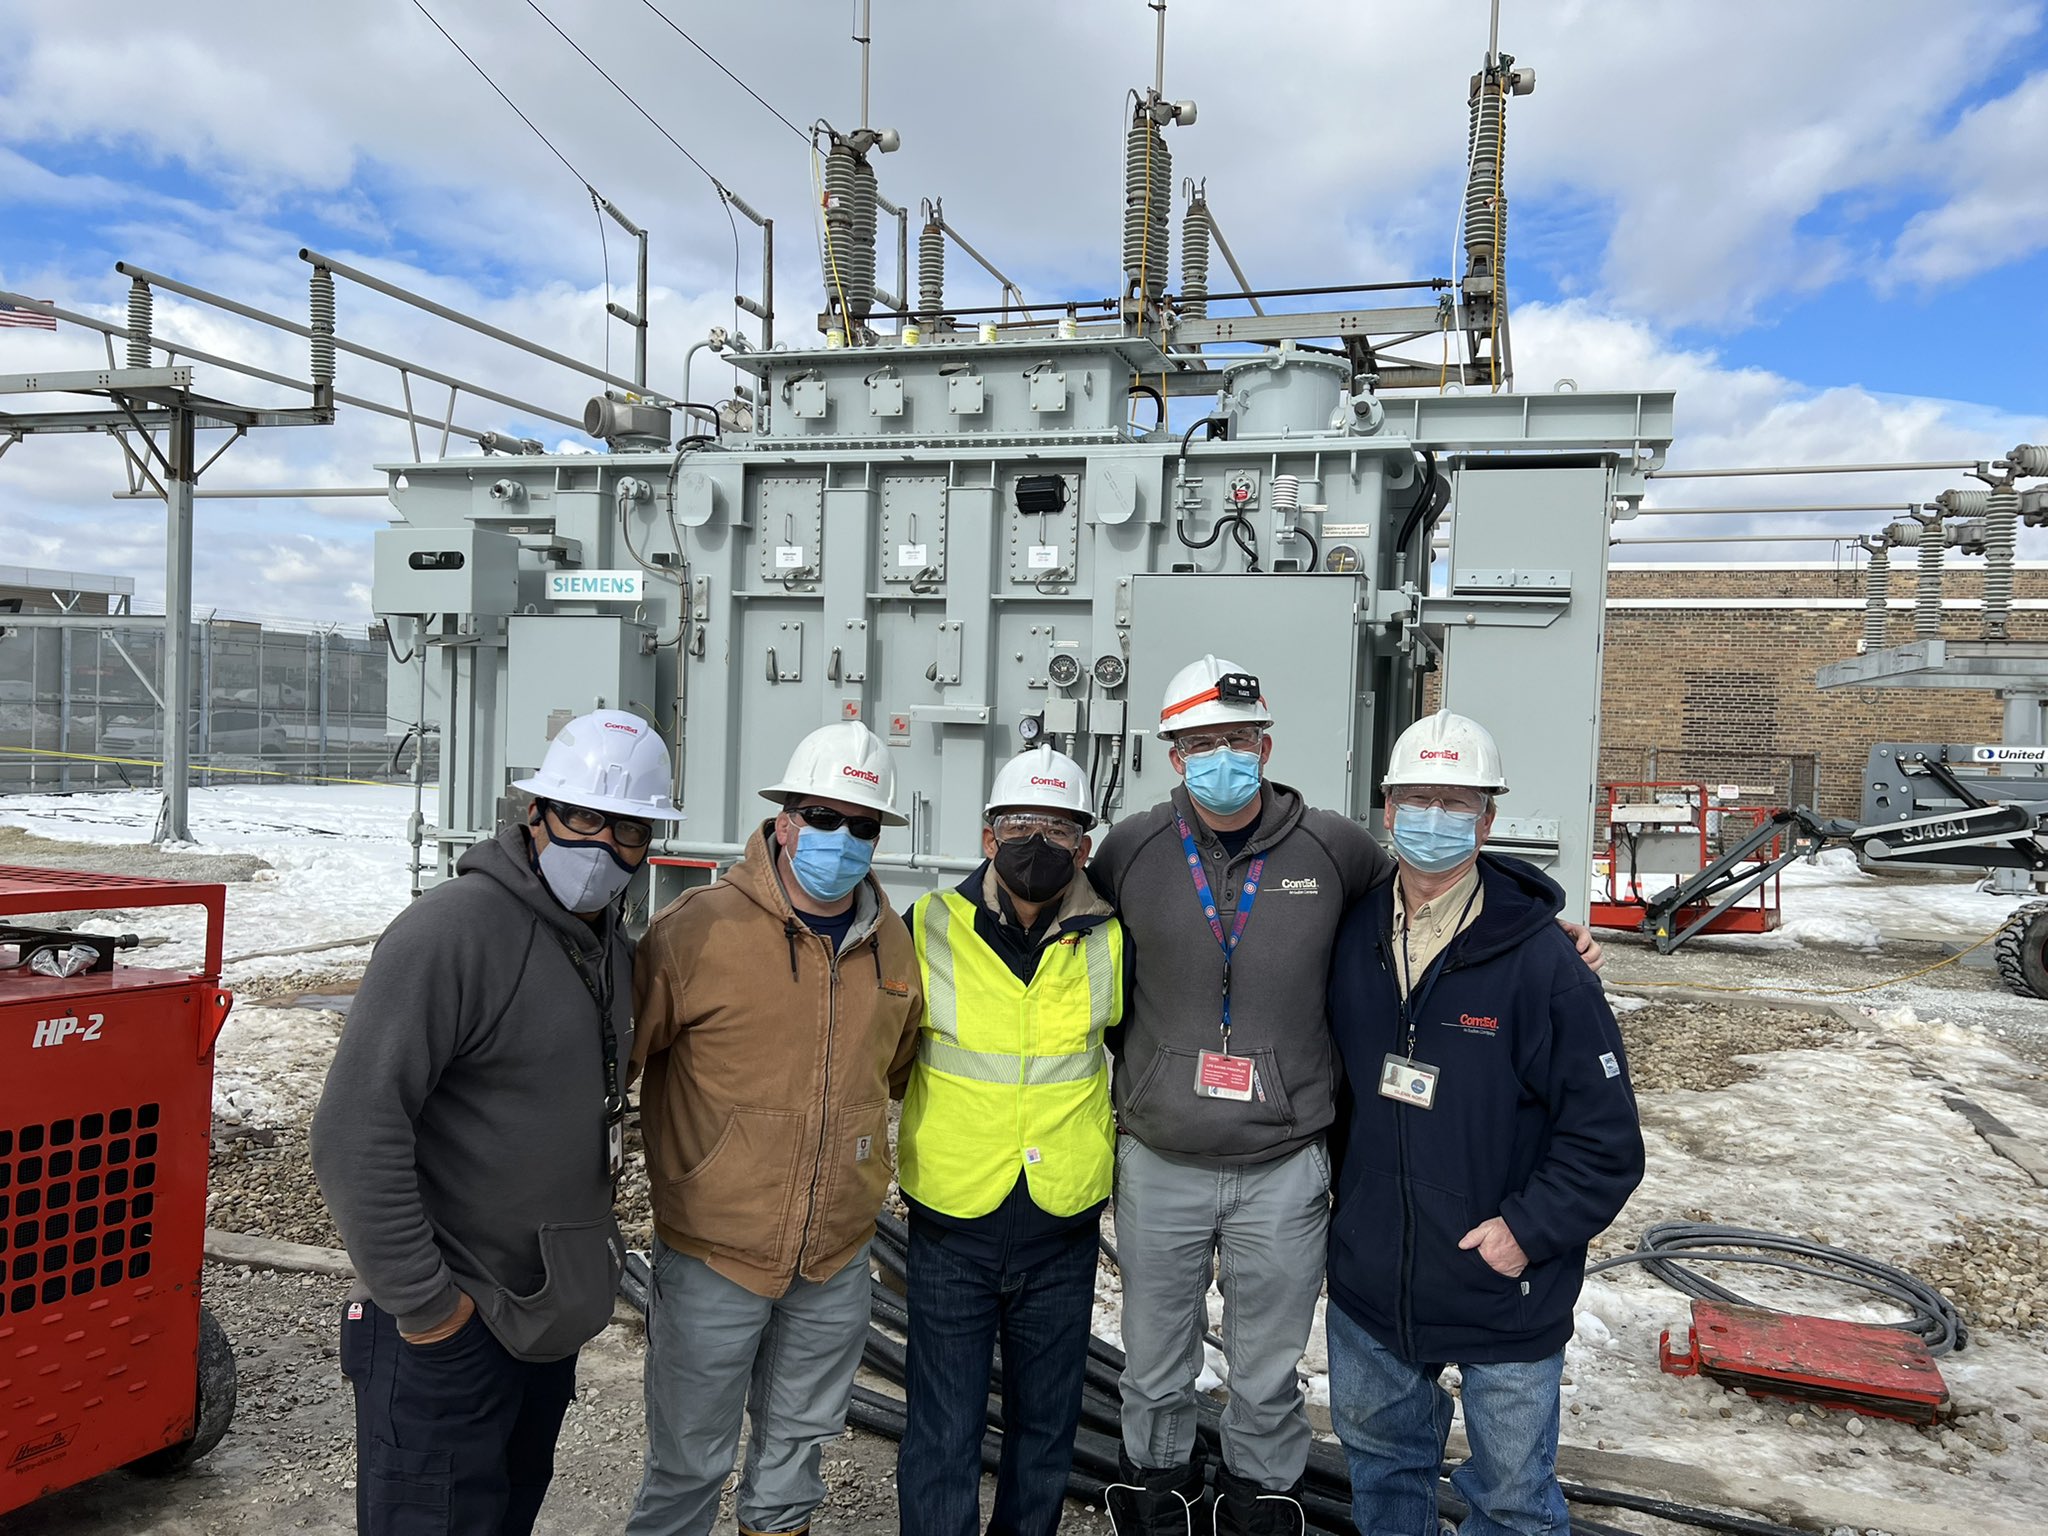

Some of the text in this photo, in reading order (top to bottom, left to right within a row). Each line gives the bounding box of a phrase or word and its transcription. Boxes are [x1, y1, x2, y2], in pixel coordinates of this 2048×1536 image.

[553, 577, 634, 593] SIEMENS
[1420, 750, 1458, 760] ComEd
[1998, 749, 2045, 760] United
[843, 766, 879, 784] ComEd
[1031, 776, 1066, 788] ComEd
[1902, 818, 1969, 842] SJ46AJ
[1281, 878, 1317, 888] ComEd
[1460, 1013, 1497, 1029] ComEd
[32, 1013, 104, 1048] HP-2
